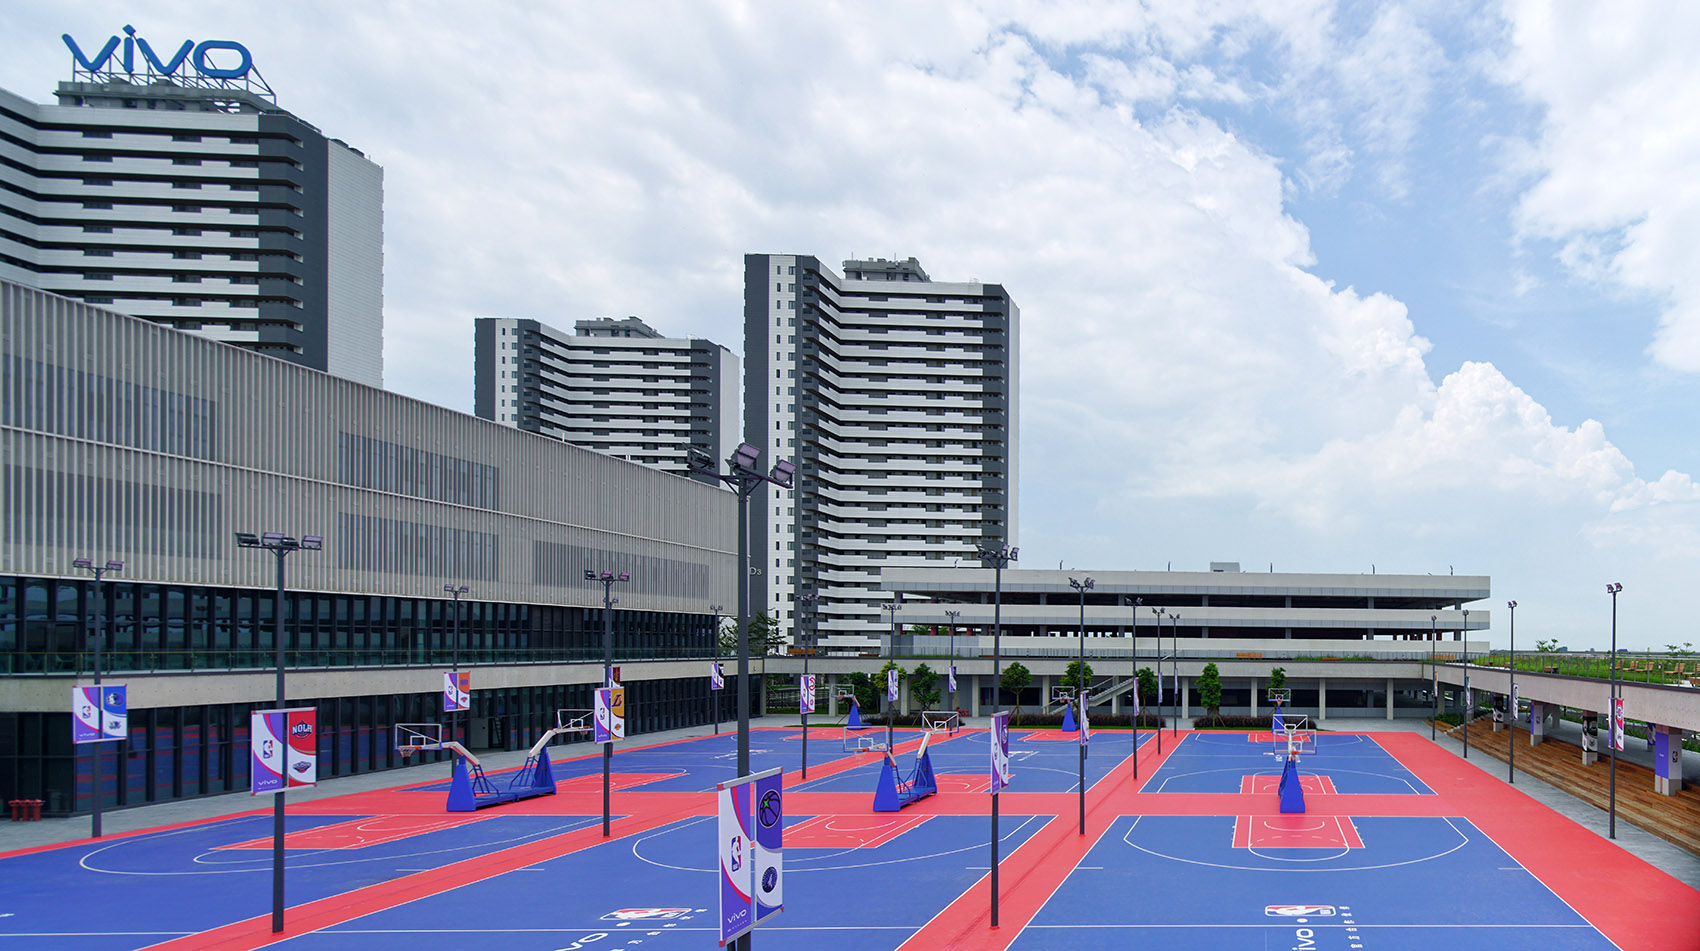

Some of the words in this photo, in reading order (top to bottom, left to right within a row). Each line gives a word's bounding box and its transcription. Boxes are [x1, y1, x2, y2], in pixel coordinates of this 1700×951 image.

[61, 24, 253, 79] vivo
[749, 567, 762, 575] D3
[727, 909, 747, 924] vivo
[1292, 928, 1317, 951] ivo
